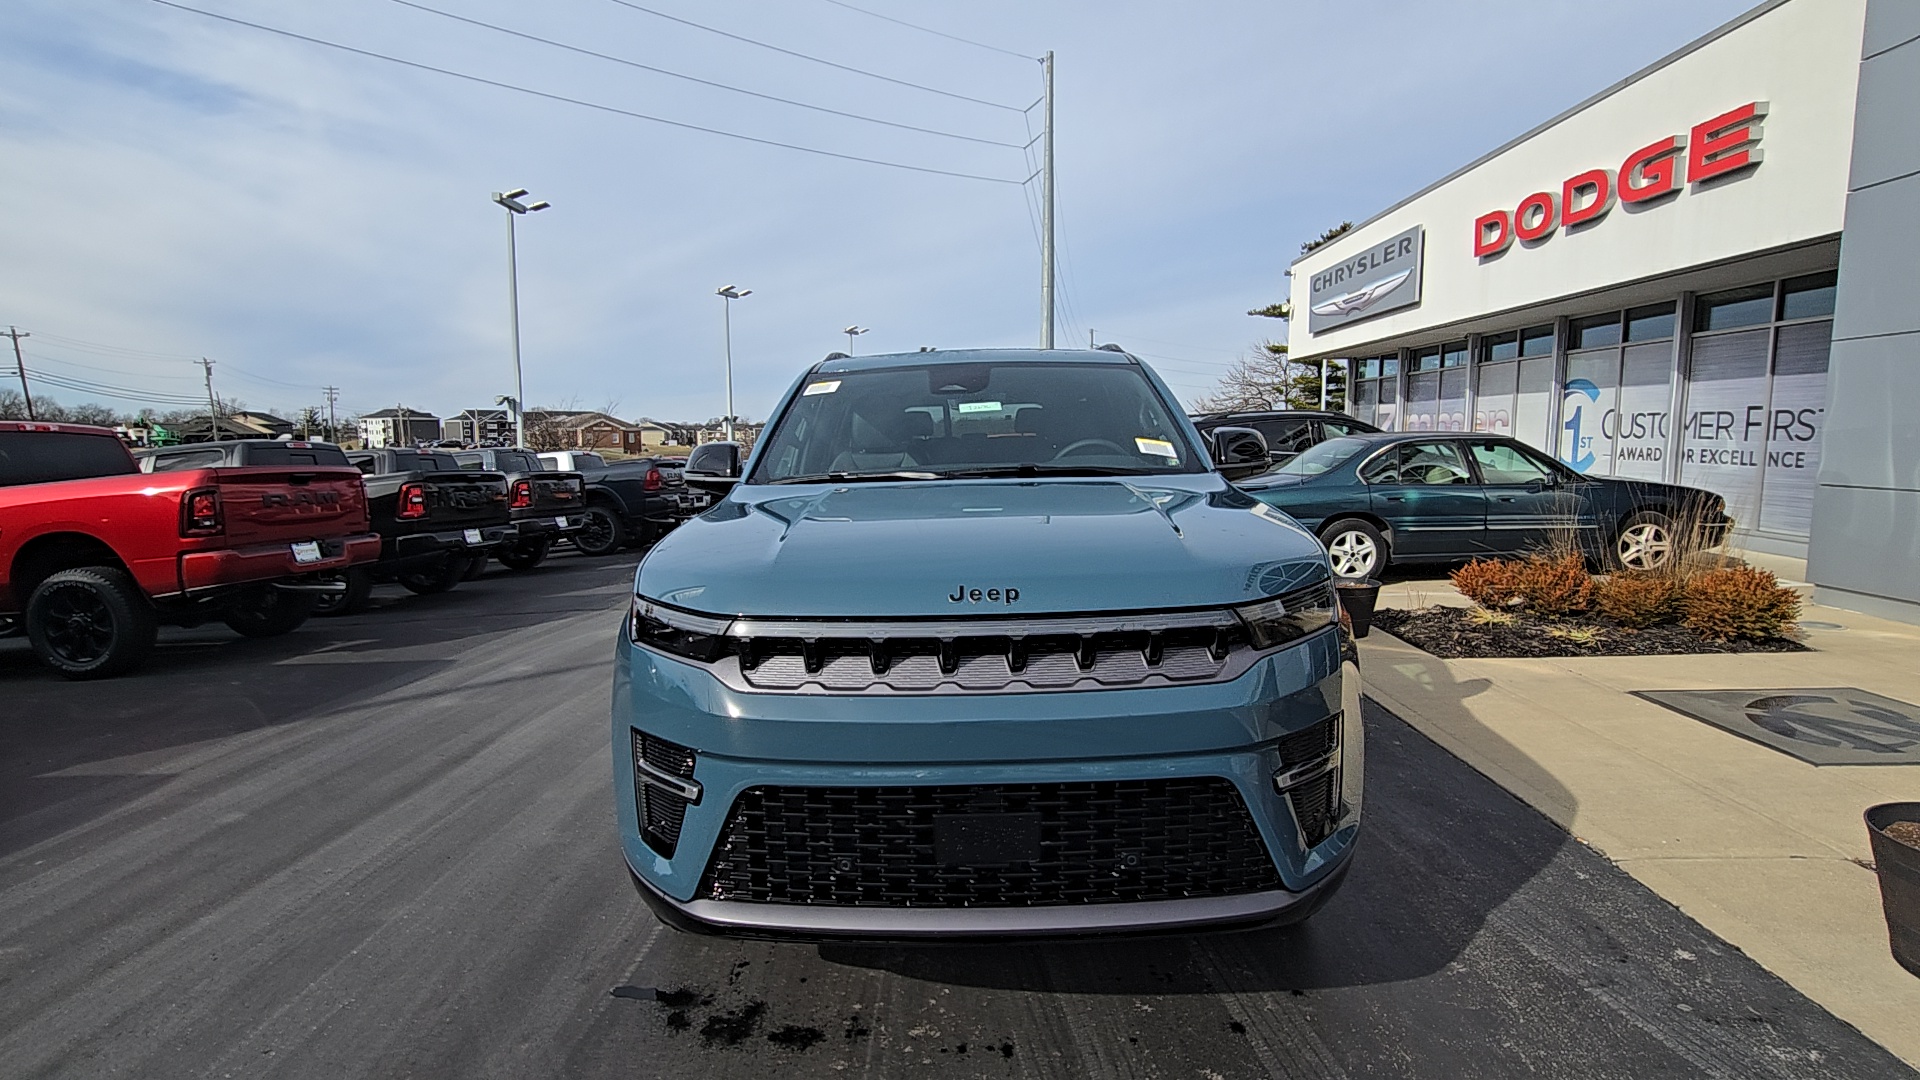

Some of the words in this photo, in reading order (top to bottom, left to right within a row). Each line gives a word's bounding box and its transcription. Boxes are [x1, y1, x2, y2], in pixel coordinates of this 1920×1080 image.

[1474, 101, 1768, 259] DODGE
[1313, 236, 1412, 293] CHRYSLER
[1743, 405, 1825, 442] FIRS
[1618, 446, 1662, 461] AWARD
[1699, 448, 1806, 468] EXCELLNCE
[262, 491, 338, 508] RAM
[949, 585, 1020, 605] Jeep
